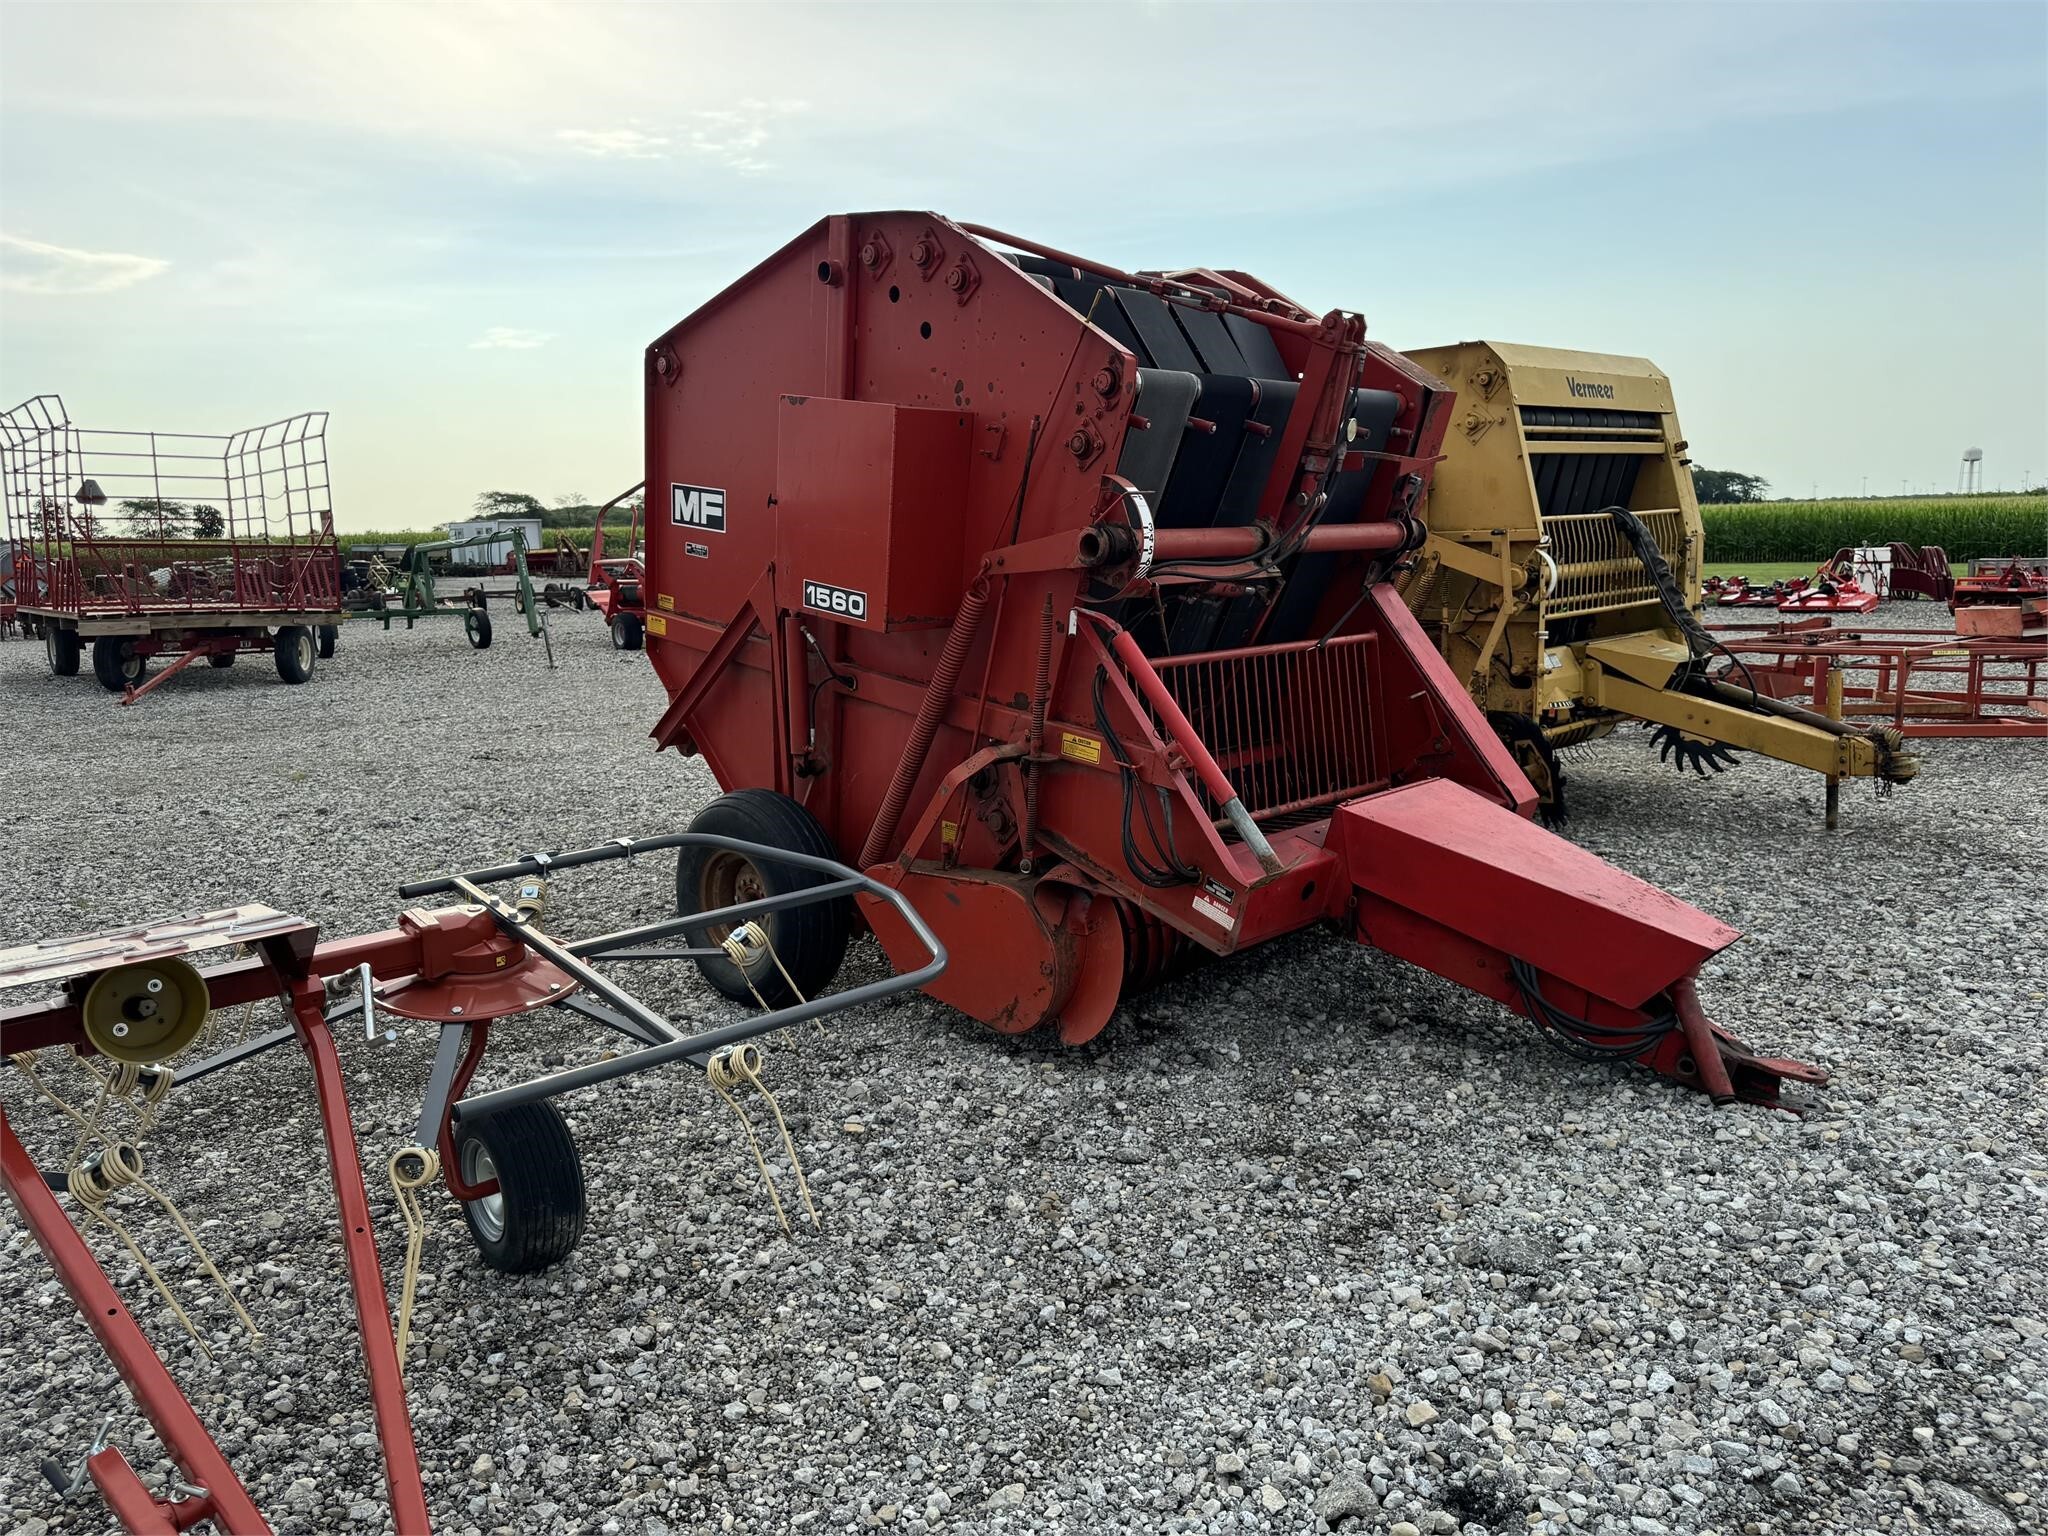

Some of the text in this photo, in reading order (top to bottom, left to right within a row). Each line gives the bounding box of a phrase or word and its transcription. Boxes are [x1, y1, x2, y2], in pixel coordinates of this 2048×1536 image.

[1566, 376, 1614, 399] Vermeer
[674, 488, 723, 525] MF
[1147, 545, 1153, 555] 5
[806, 585, 864, 616] 1560
